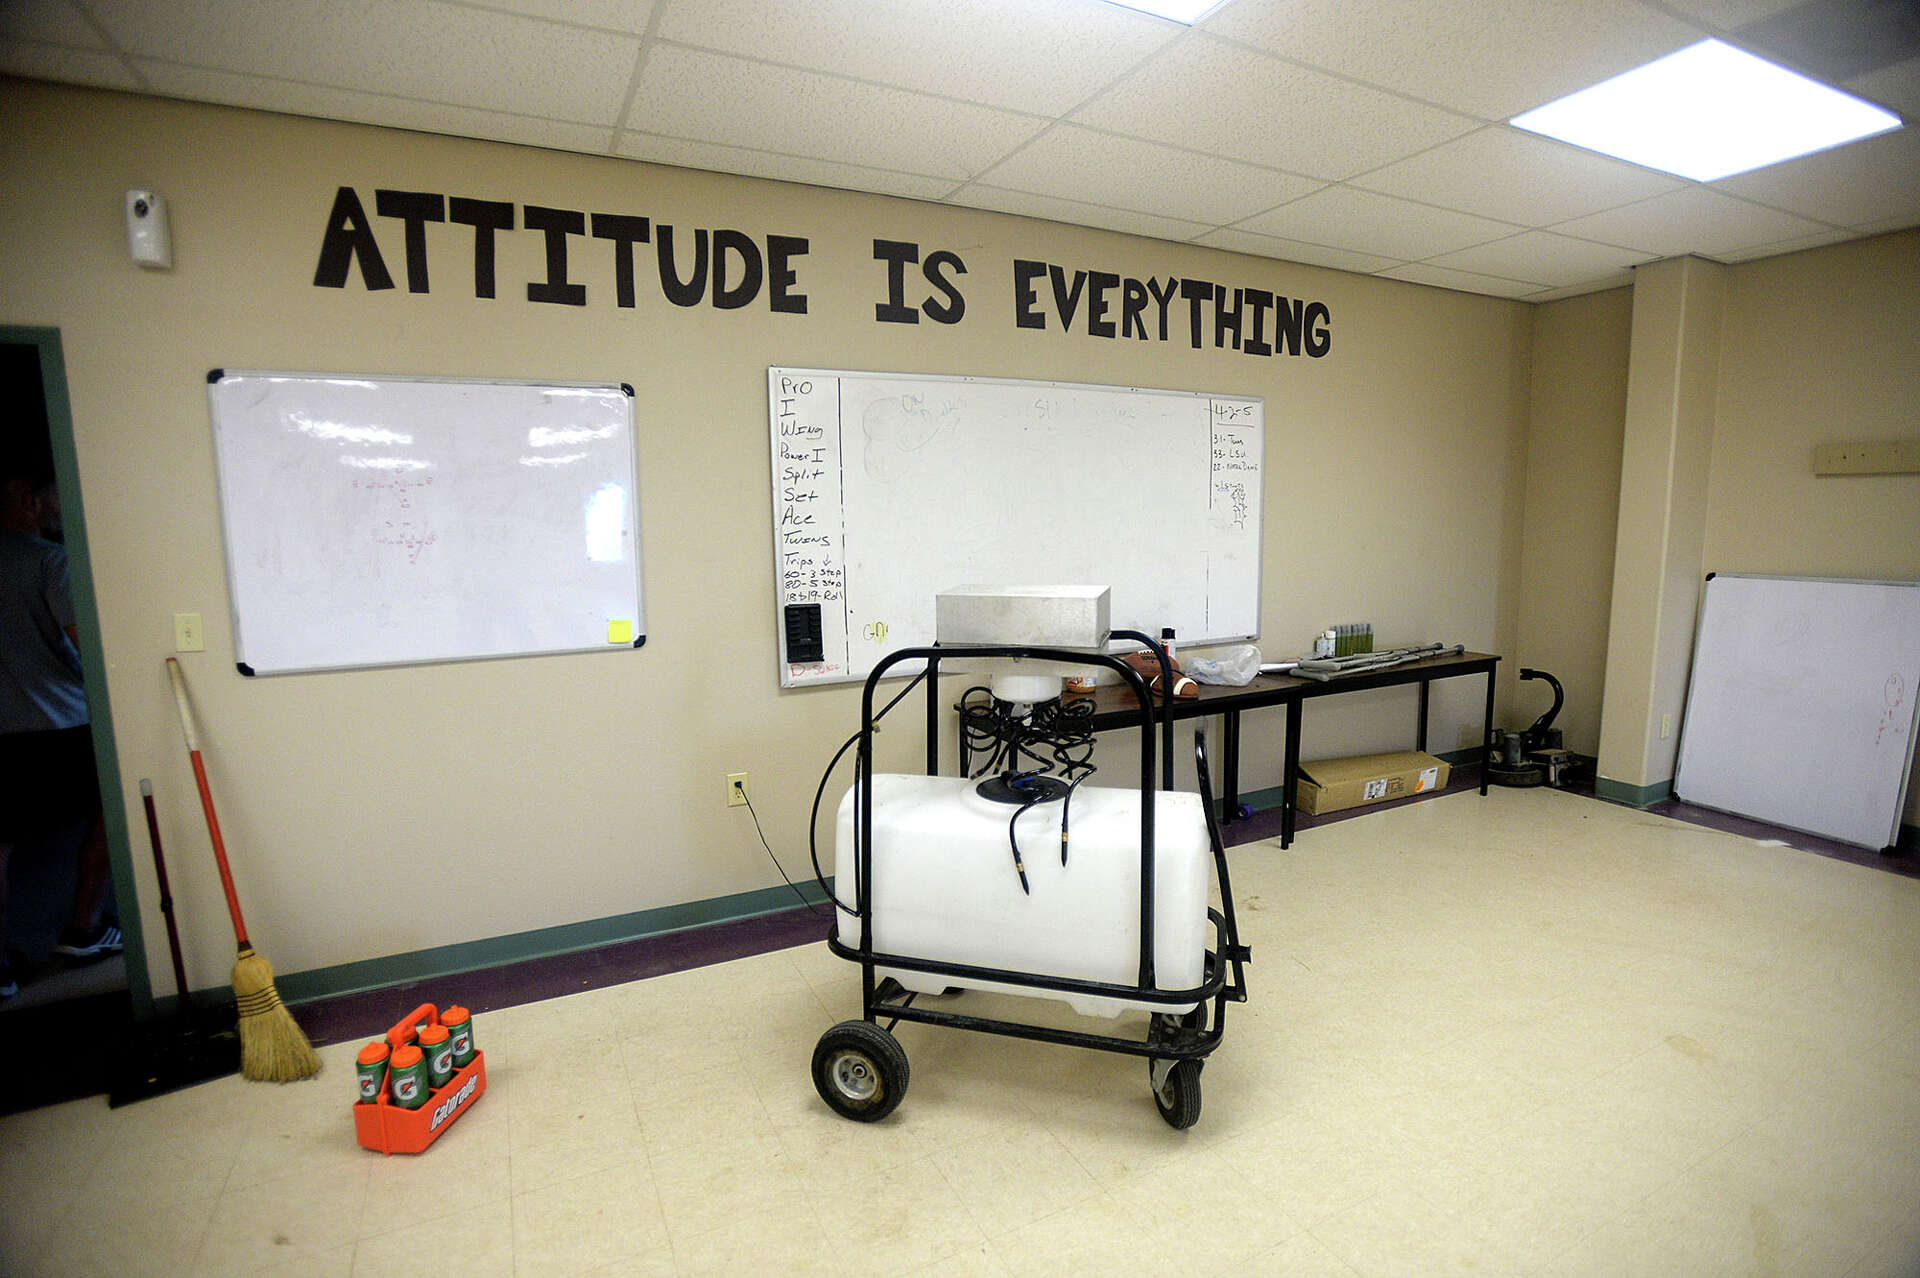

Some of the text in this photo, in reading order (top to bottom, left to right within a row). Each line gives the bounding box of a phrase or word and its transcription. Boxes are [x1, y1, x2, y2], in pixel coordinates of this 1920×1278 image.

[313, 186, 1331, 359] ATTITUDE IS EVERYTHING
[780, 398, 795, 417] I
[780, 441, 826, 463] Power I
[782, 467, 824, 485] Split
[784, 487, 819, 502] Set
[782, 505, 816, 525] Ace
[784, 551, 814, 569] Trips
[394, 1076, 418, 1100] G
